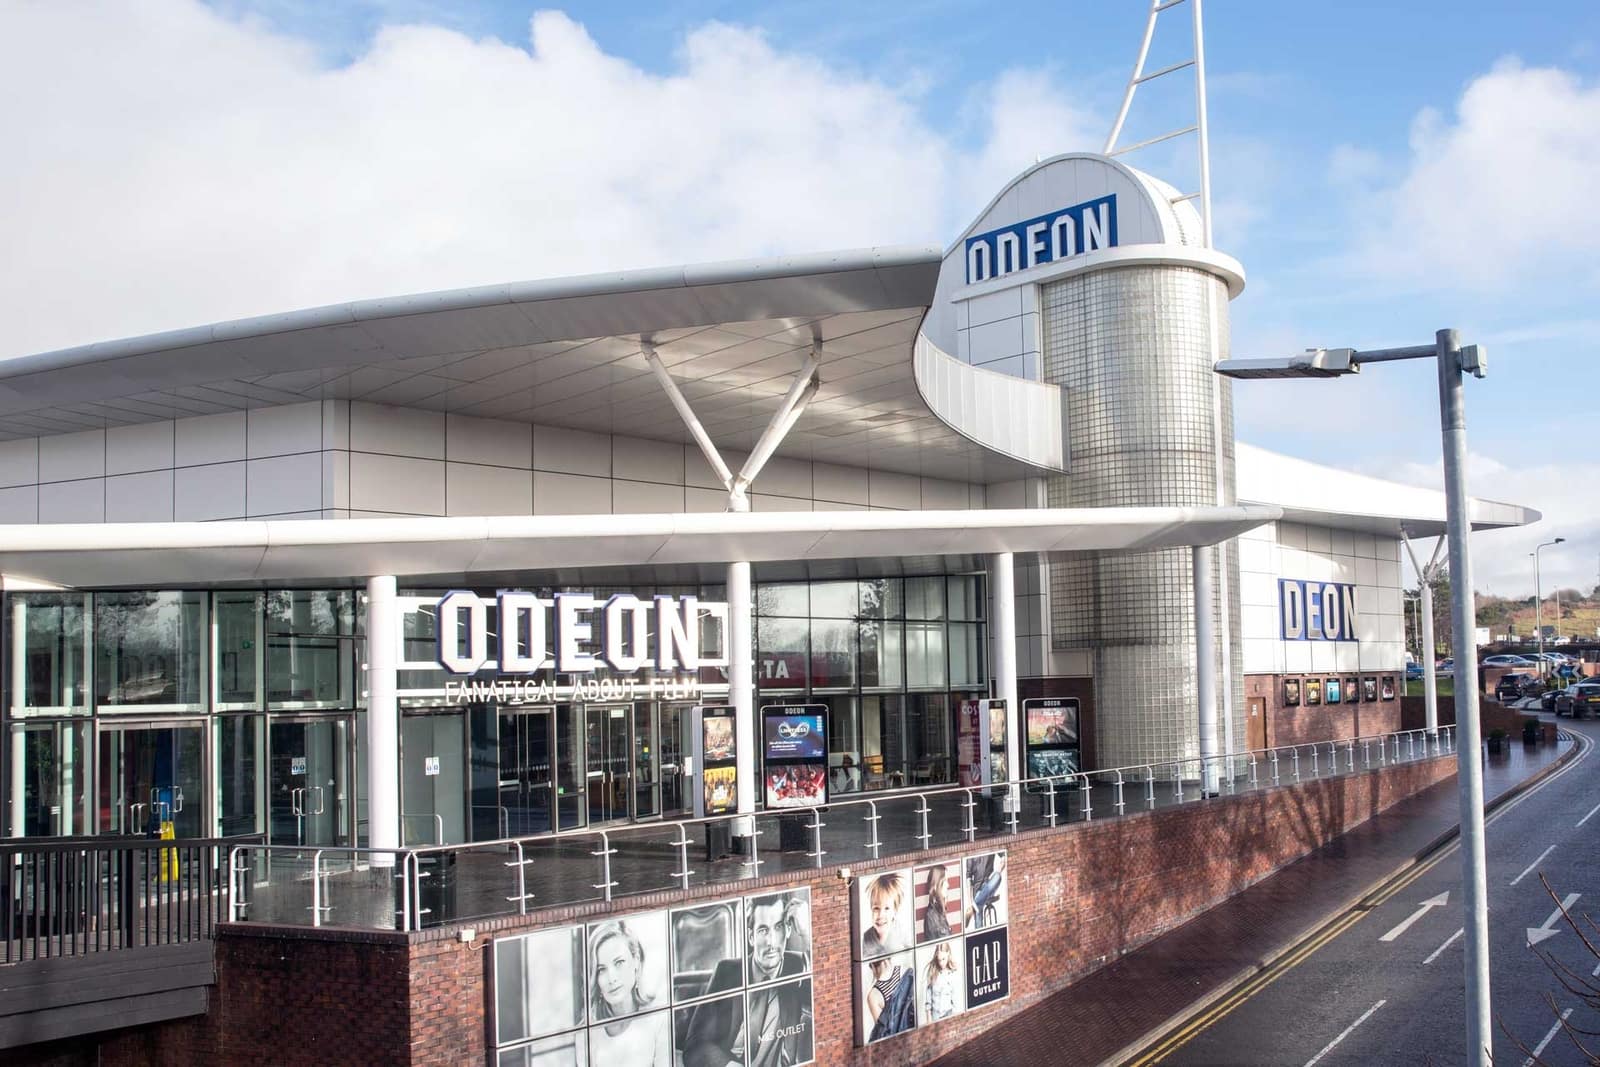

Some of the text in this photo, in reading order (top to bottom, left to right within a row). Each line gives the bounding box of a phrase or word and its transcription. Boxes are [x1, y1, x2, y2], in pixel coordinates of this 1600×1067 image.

[968, 202, 1110, 285] ODEON
[1281, 580, 1360, 640] DEON
[435, 589, 698, 676] ODEON
[444, 677, 698, 703] FANATICAL ABOUT FILM
[961, 704, 980, 716] COS
[972, 941, 1001, 986] GAP
[973, 981, 1001, 997] OUTLET
[776, 1022, 806, 1039] OUTLET
